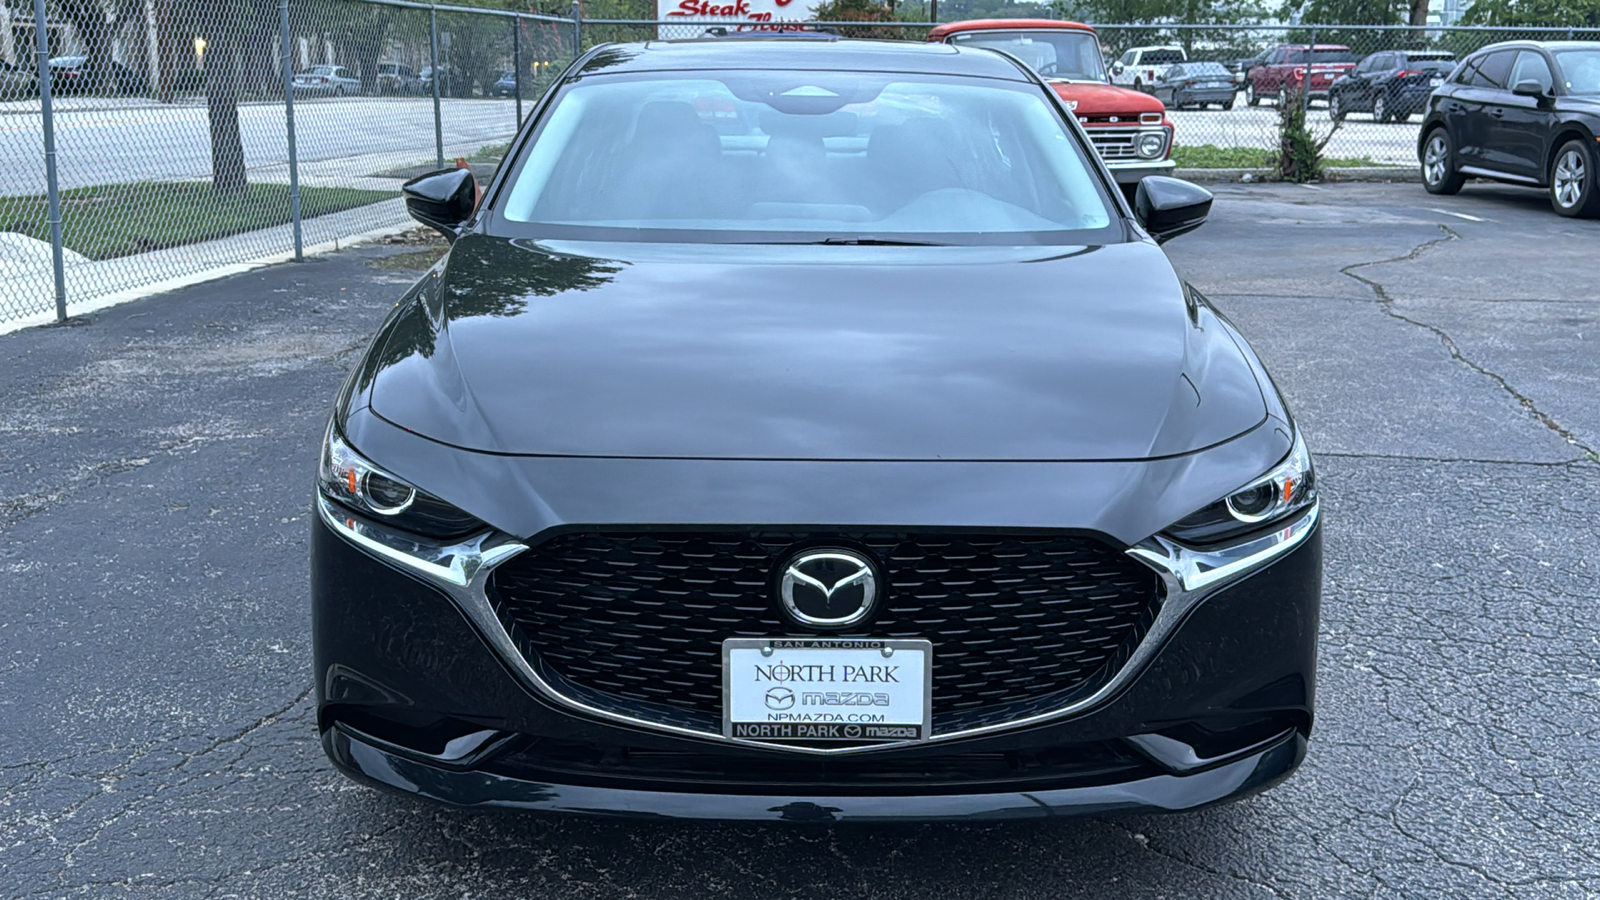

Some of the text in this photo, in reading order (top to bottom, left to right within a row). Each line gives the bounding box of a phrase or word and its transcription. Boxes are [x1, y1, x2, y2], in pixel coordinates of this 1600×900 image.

[667, 0, 750, 16] Steak
[754, 662, 900, 684] NORTH PARK
[802, 692, 889, 706] mazda
[767, 713, 885, 722] NPMAZDA.COM
[736, 724, 917, 738] NORTH PARK mazda
